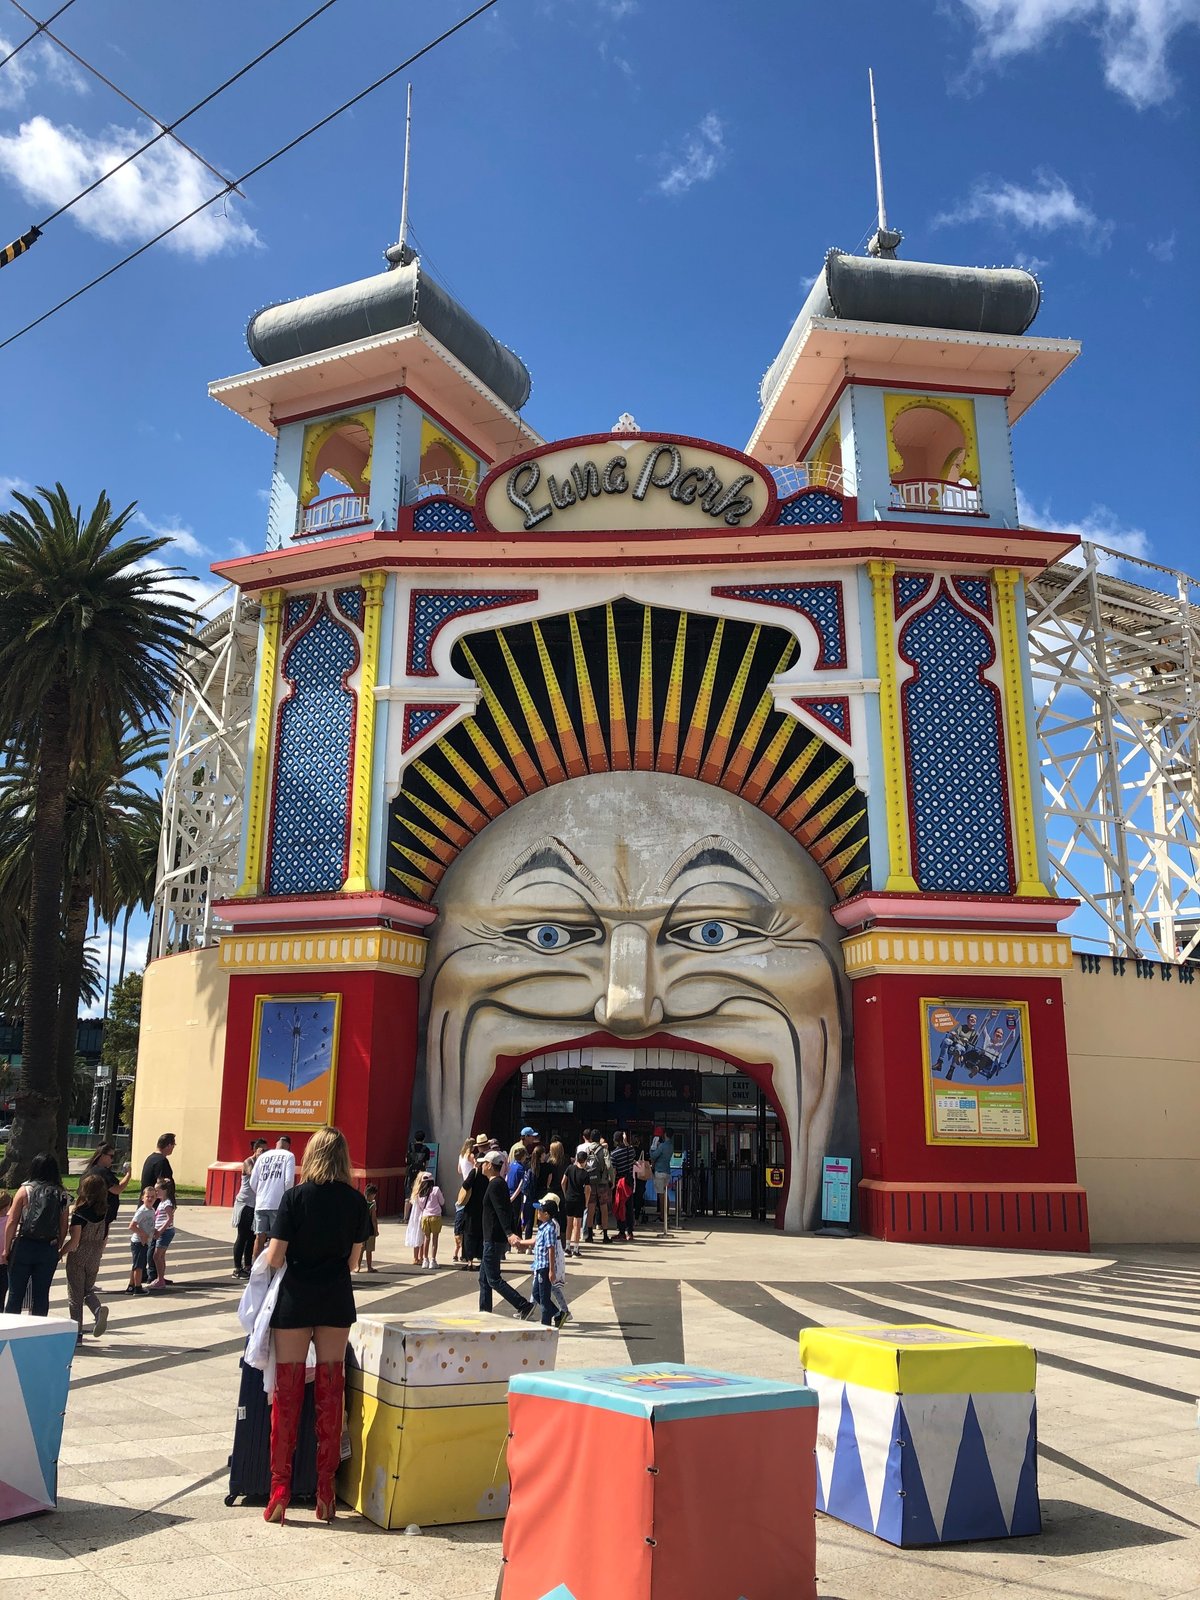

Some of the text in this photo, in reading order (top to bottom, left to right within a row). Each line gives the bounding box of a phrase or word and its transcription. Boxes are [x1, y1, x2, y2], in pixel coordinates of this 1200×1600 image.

[507, 443, 754, 530] Luna Park
[641, 1079, 673, 1088] GENERAL
[639, 1089, 677, 1098] ADMISSION
[261, 1155, 286, 1164] COFFEE
